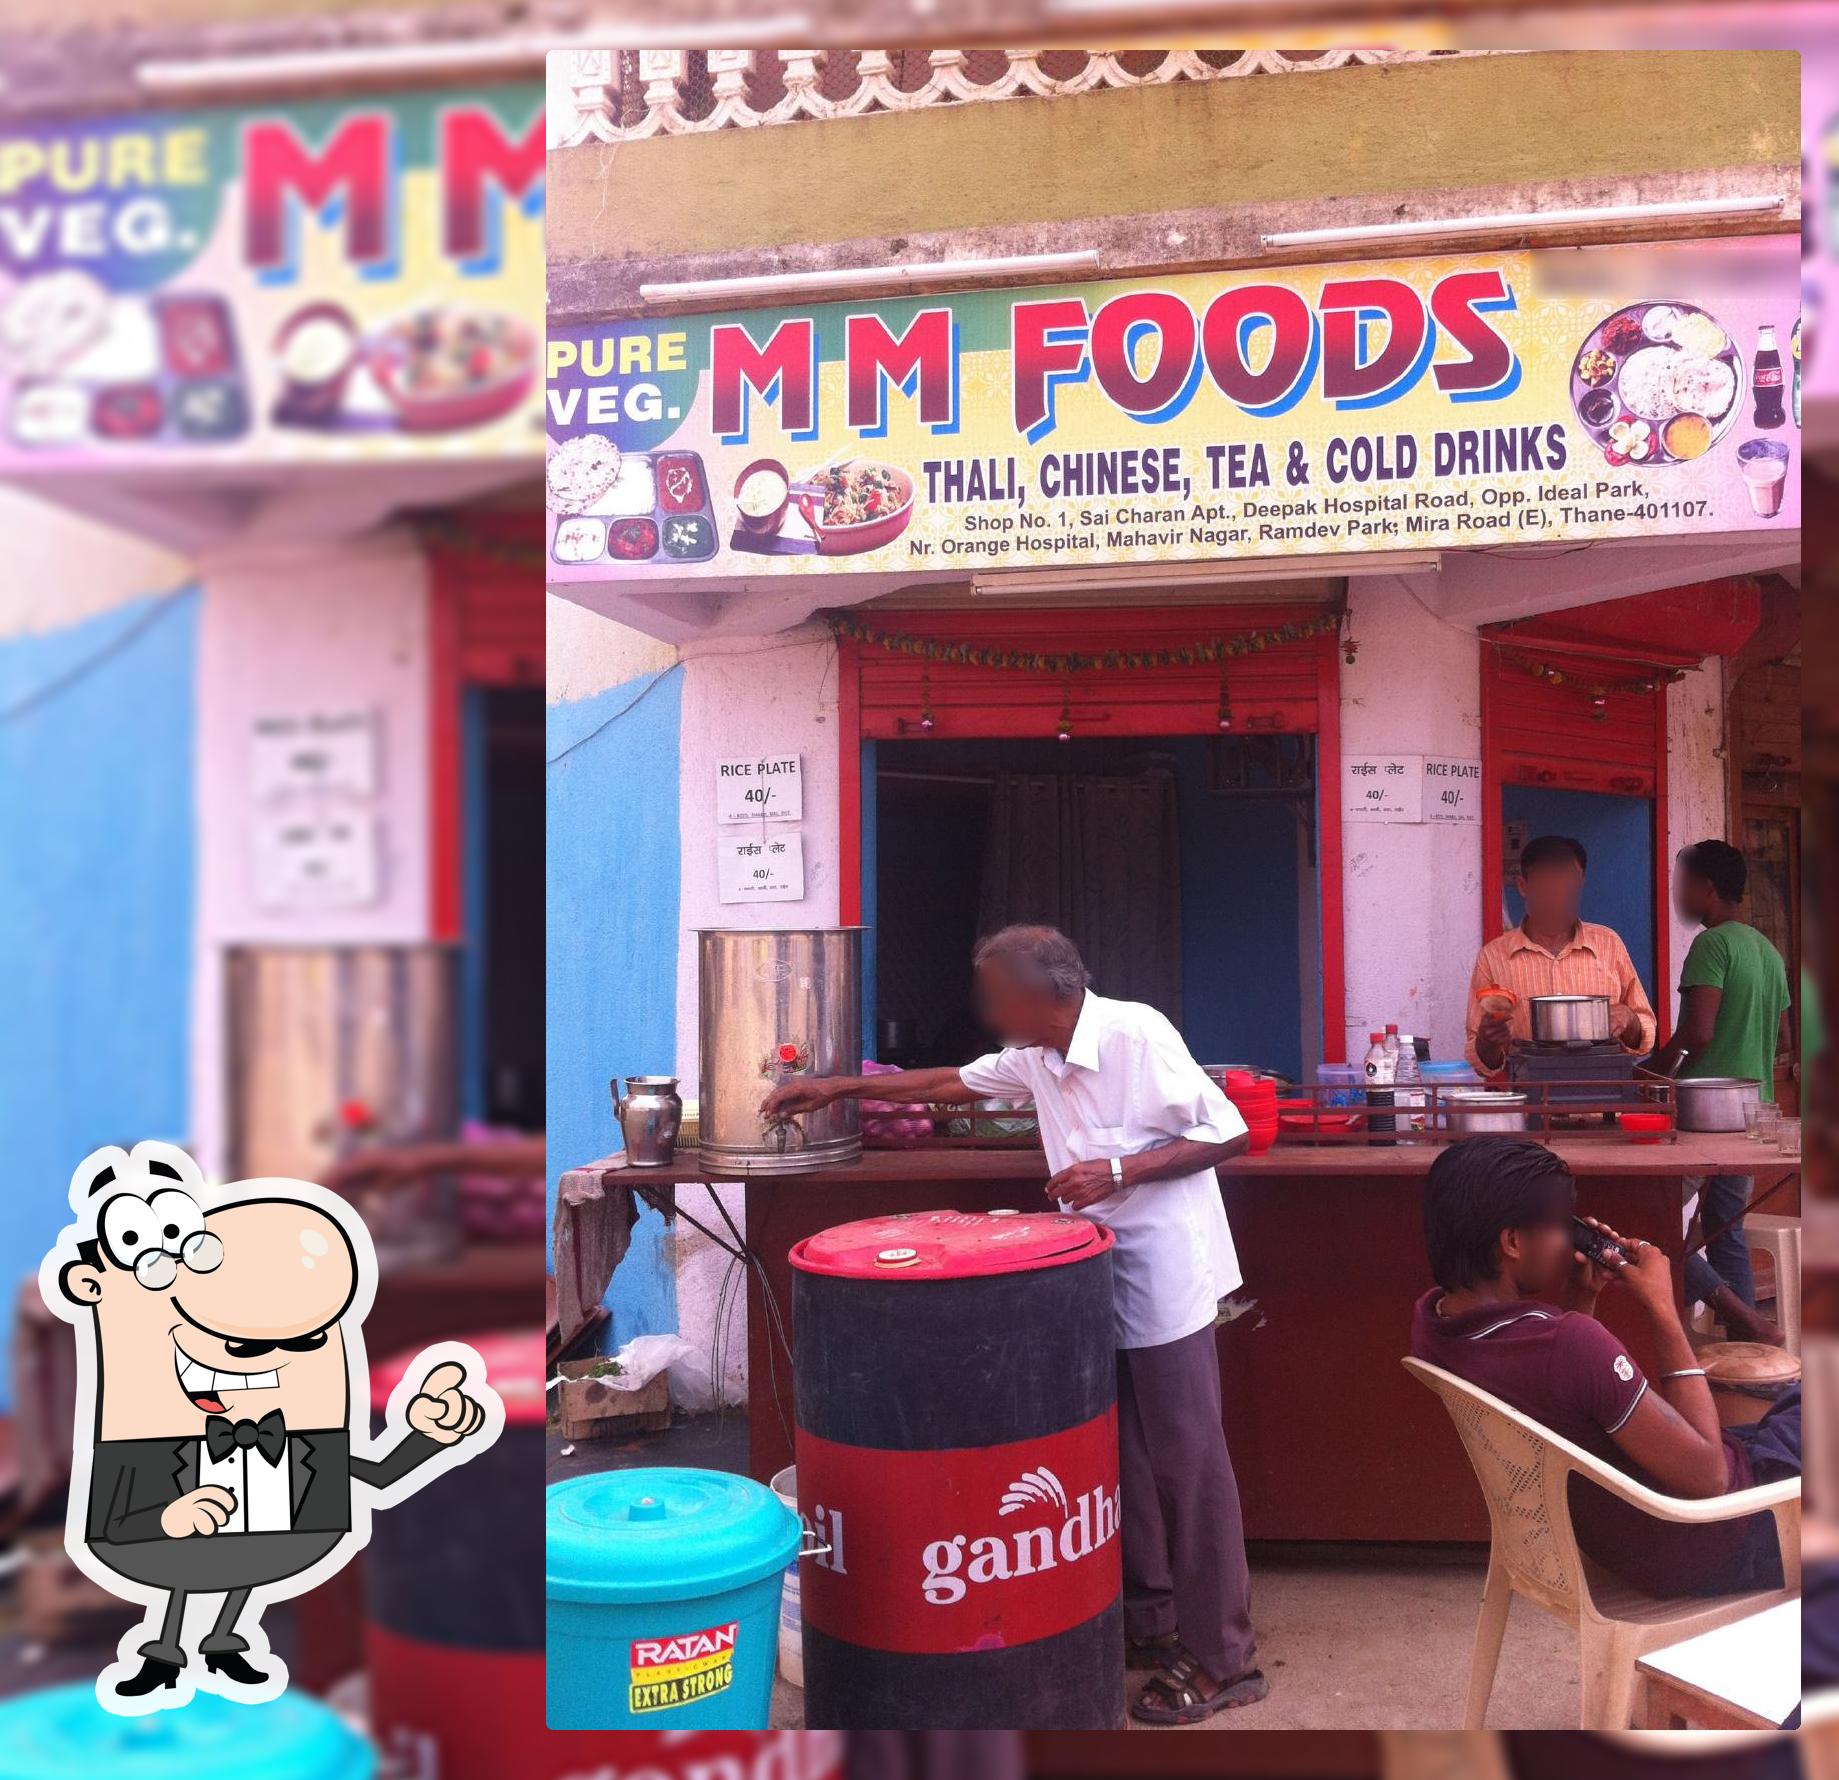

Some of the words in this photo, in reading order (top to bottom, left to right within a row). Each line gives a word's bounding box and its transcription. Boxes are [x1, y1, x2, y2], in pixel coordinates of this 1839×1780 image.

[547, 332, 687, 379] PURE
[1010, 271, 1519, 446] FOODS
[547, 383, 680, 425] VEG.
[923, 457, 1026, 509] THALI,
[1039, 447, 1191, 501] CHINESE,
[1206, 443, 1270, 489] TEA
[1286, 440, 1310, 486] &
[1326, 433, 1418, 484] COLD
[1434, 423, 1567, 478] DRINKS
[965, 514, 1014, 532] Shop
[1019, 512, 1051, 529] No.
[1057, 511, 1074, 528] 1,
[1080, 508, 1109, 526] Sai
[1116, 505, 1185, 525] Charan
[1191, 503, 1236, 523] Apt.,
[1243, 501, 1317, 522] Deepak
[1324, 493, 1408, 515] Hospital
[1415, 490, 1474, 510] Road,
[1481, 487, 1531, 507] Opp.
[1538, 482, 1588, 503] Ideal
[1595, 479, 1649, 500] Park,
[910, 539, 935, 555] Nr.
[941, 536, 1010, 557] Orange
[1016, 532, 1099, 555] Hospital,
[1107, 528, 1184, 549] Mahavir
[1191, 526, 1252, 547] Nagar,
[1259, 521, 1344, 541] Ramdev
[1406, 514, 1450, 532] Mira
[1457, 511, 1511, 530] Road
[1518, 509, 1553, 529] (E),
[1560, 500, 1714, 524] Thane-401107.
[721, 764, 751, 777] RICE
[757, 760, 796, 775] PLATE
[1351, 762, 1377, 776] राईस
[1426, 763, 1448, 776] RICE
[1451, 764, 1480, 779] PLATE
[744, 787, 777, 805] 40/-
[1365, 789, 1389, 801] 40/-
[1441, 789, 1464, 807] 40/-
[736, 842, 762, 856] राईस
[752, 868, 775, 880] 40/-
[634, 1623, 738, 1665] RATAN
[634, 1682, 679, 1707] EXTRA
[682, 1663, 733, 1700] STRONG
